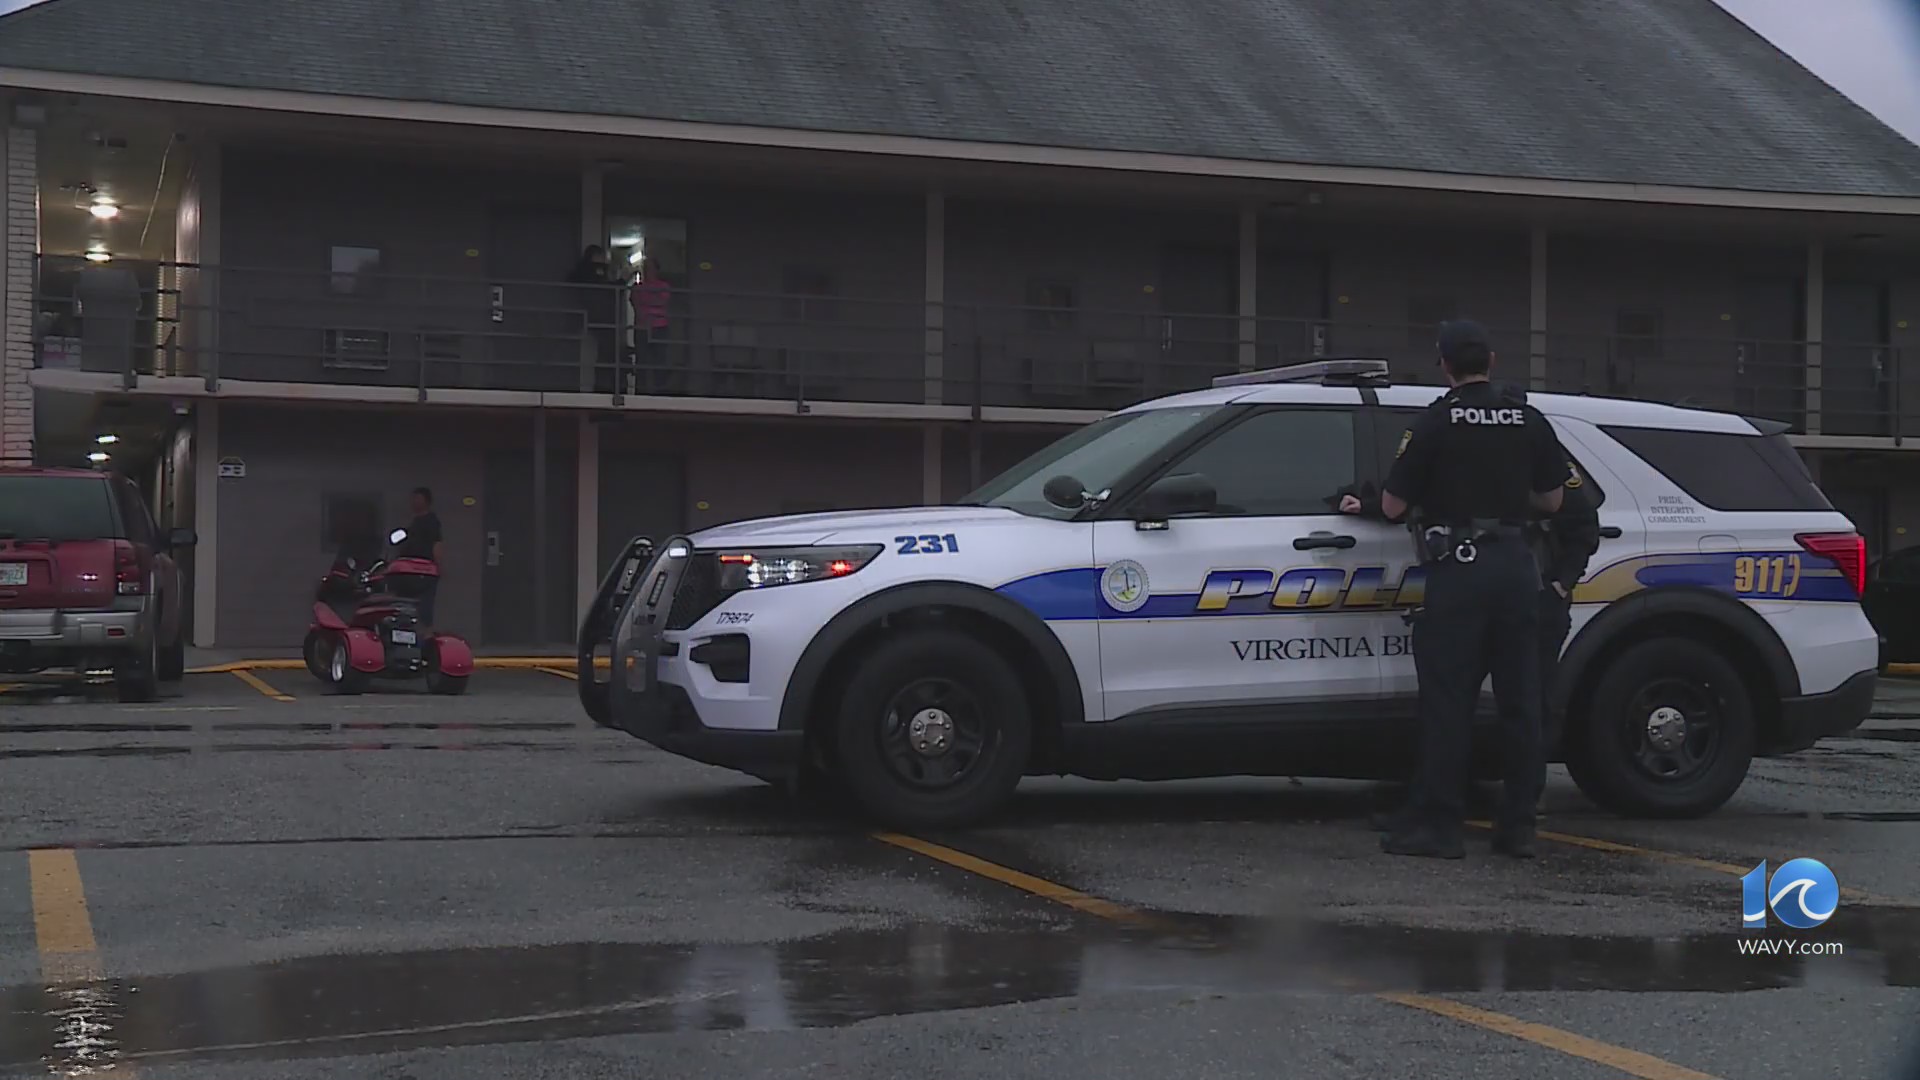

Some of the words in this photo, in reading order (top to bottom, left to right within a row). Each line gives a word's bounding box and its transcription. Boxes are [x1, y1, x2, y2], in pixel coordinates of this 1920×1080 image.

[1450, 407, 1525, 425] POLICE
[1658, 495, 1683, 504] PRIDE
[1647, 515, 1706, 523] COMMITMENT
[1650, 506, 1695, 514] INTEGRITY
[894, 533, 959, 555] 231
[1734, 556, 1785, 593] 911
[1230, 636, 1374, 661] VIRGINIA
